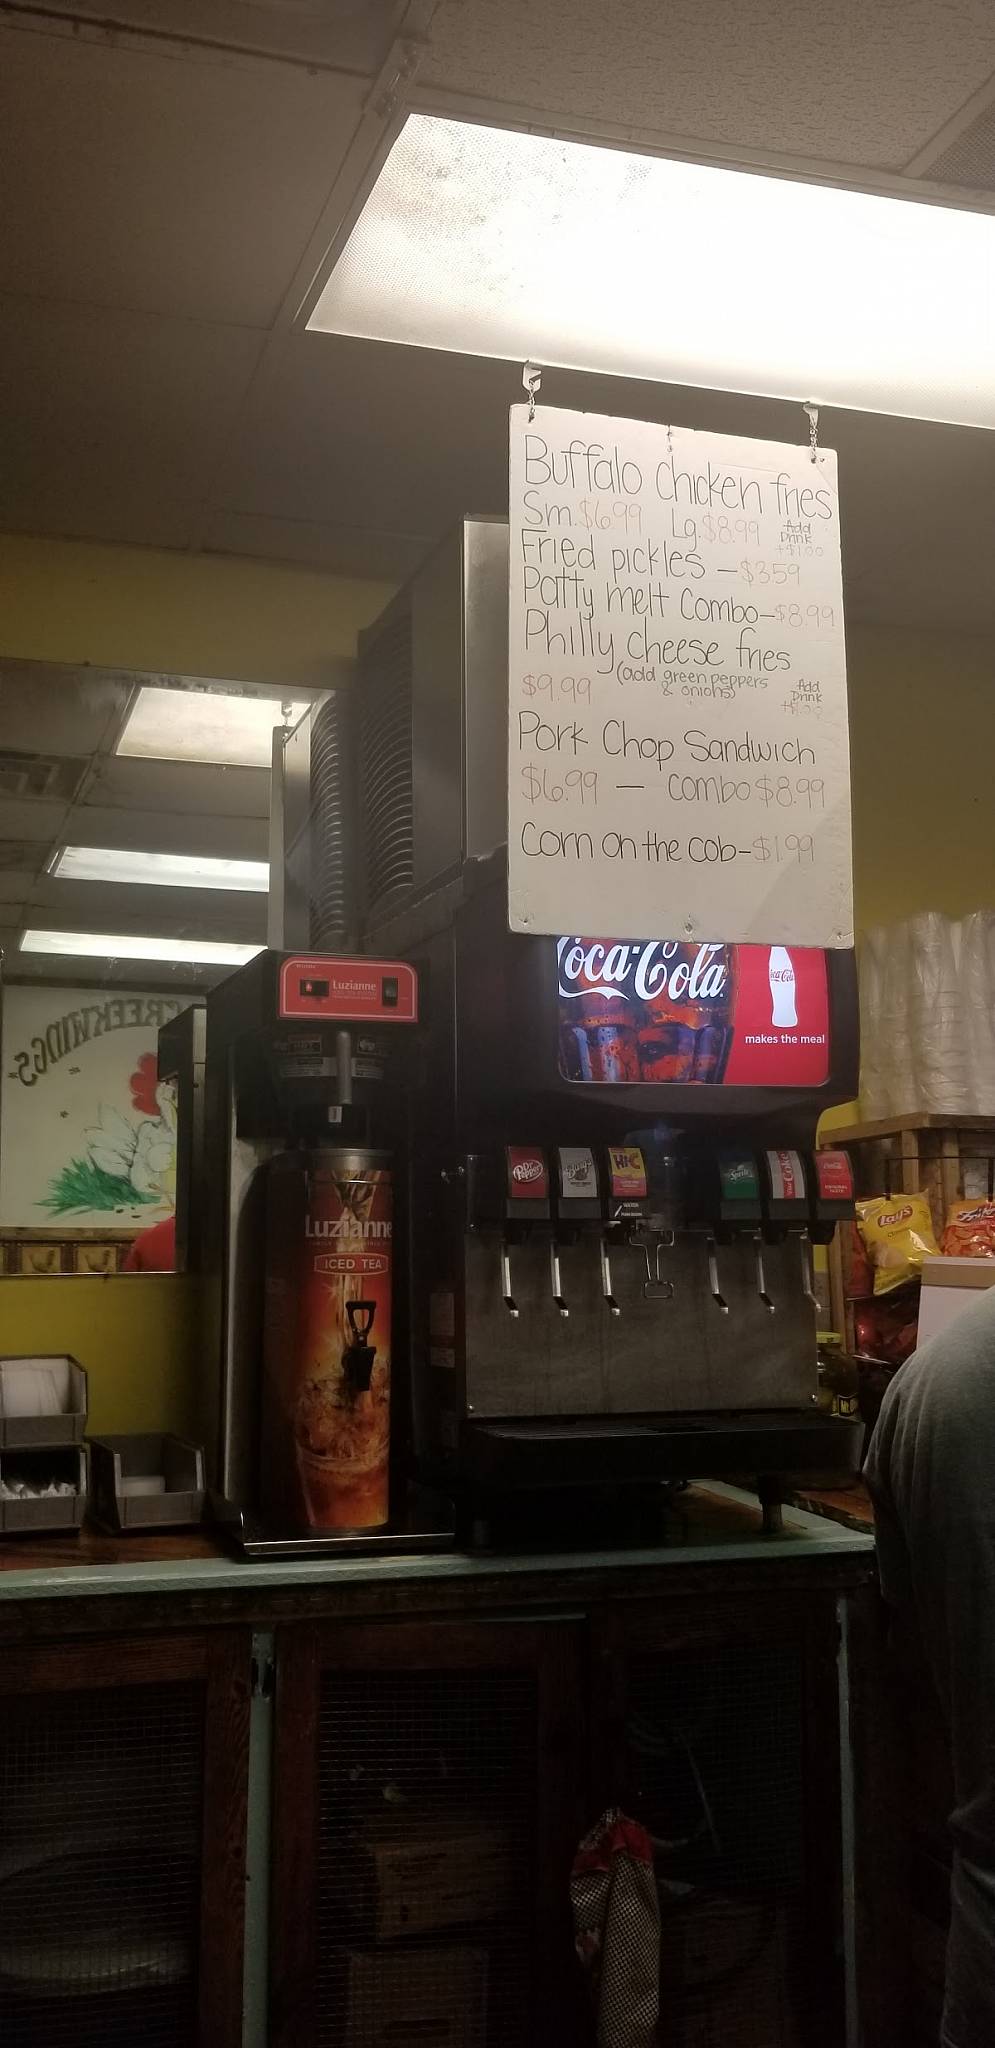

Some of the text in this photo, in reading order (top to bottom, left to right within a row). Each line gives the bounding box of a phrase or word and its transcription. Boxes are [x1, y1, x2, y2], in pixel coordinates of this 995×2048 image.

[525, 435, 832, 519] Buffalo chicken fries
[523, 490, 577, 527] Sm.
[672, 508, 702, 552] Lg.
[703, 511, 760, 546] $8.99
[783, 519, 811, 534] Add
[780, 532, 813, 545] Drink
[521, 529, 596, 570] Fried
[612, 538, 706, 584] pickles
[524, 566, 594, 620] Patty
[607, 582, 669, 617] melt
[525, 608, 791, 674] Philly cheese fries
[522, 673, 591, 704] $9.99
[616, 661, 768, 693] (add green peppers
[662, 681, 673, 696] &
[797, 678, 820, 693] Add
[790, 690, 823, 702] Drink
[519, 711, 815, 771] Pork Chop Sandwich
[522, 762, 597, 804] $6.99
[755, 774, 825, 808] $8.99
[521, 822, 593, 859] Corn
[641, 830, 682, 862] the
[333, 979, 377, 991] Luzianne
[745, 1033, 825, 1044] makes the meal
[513, 1164, 541, 1181] Pepper
[523, 1161, 534, 1171] Dr
[779, 1151, 794, 1182] Coke
[305, 1214, 393, 1238] Luzianne
[325, 1259, 382, 1269] ICED TEA
